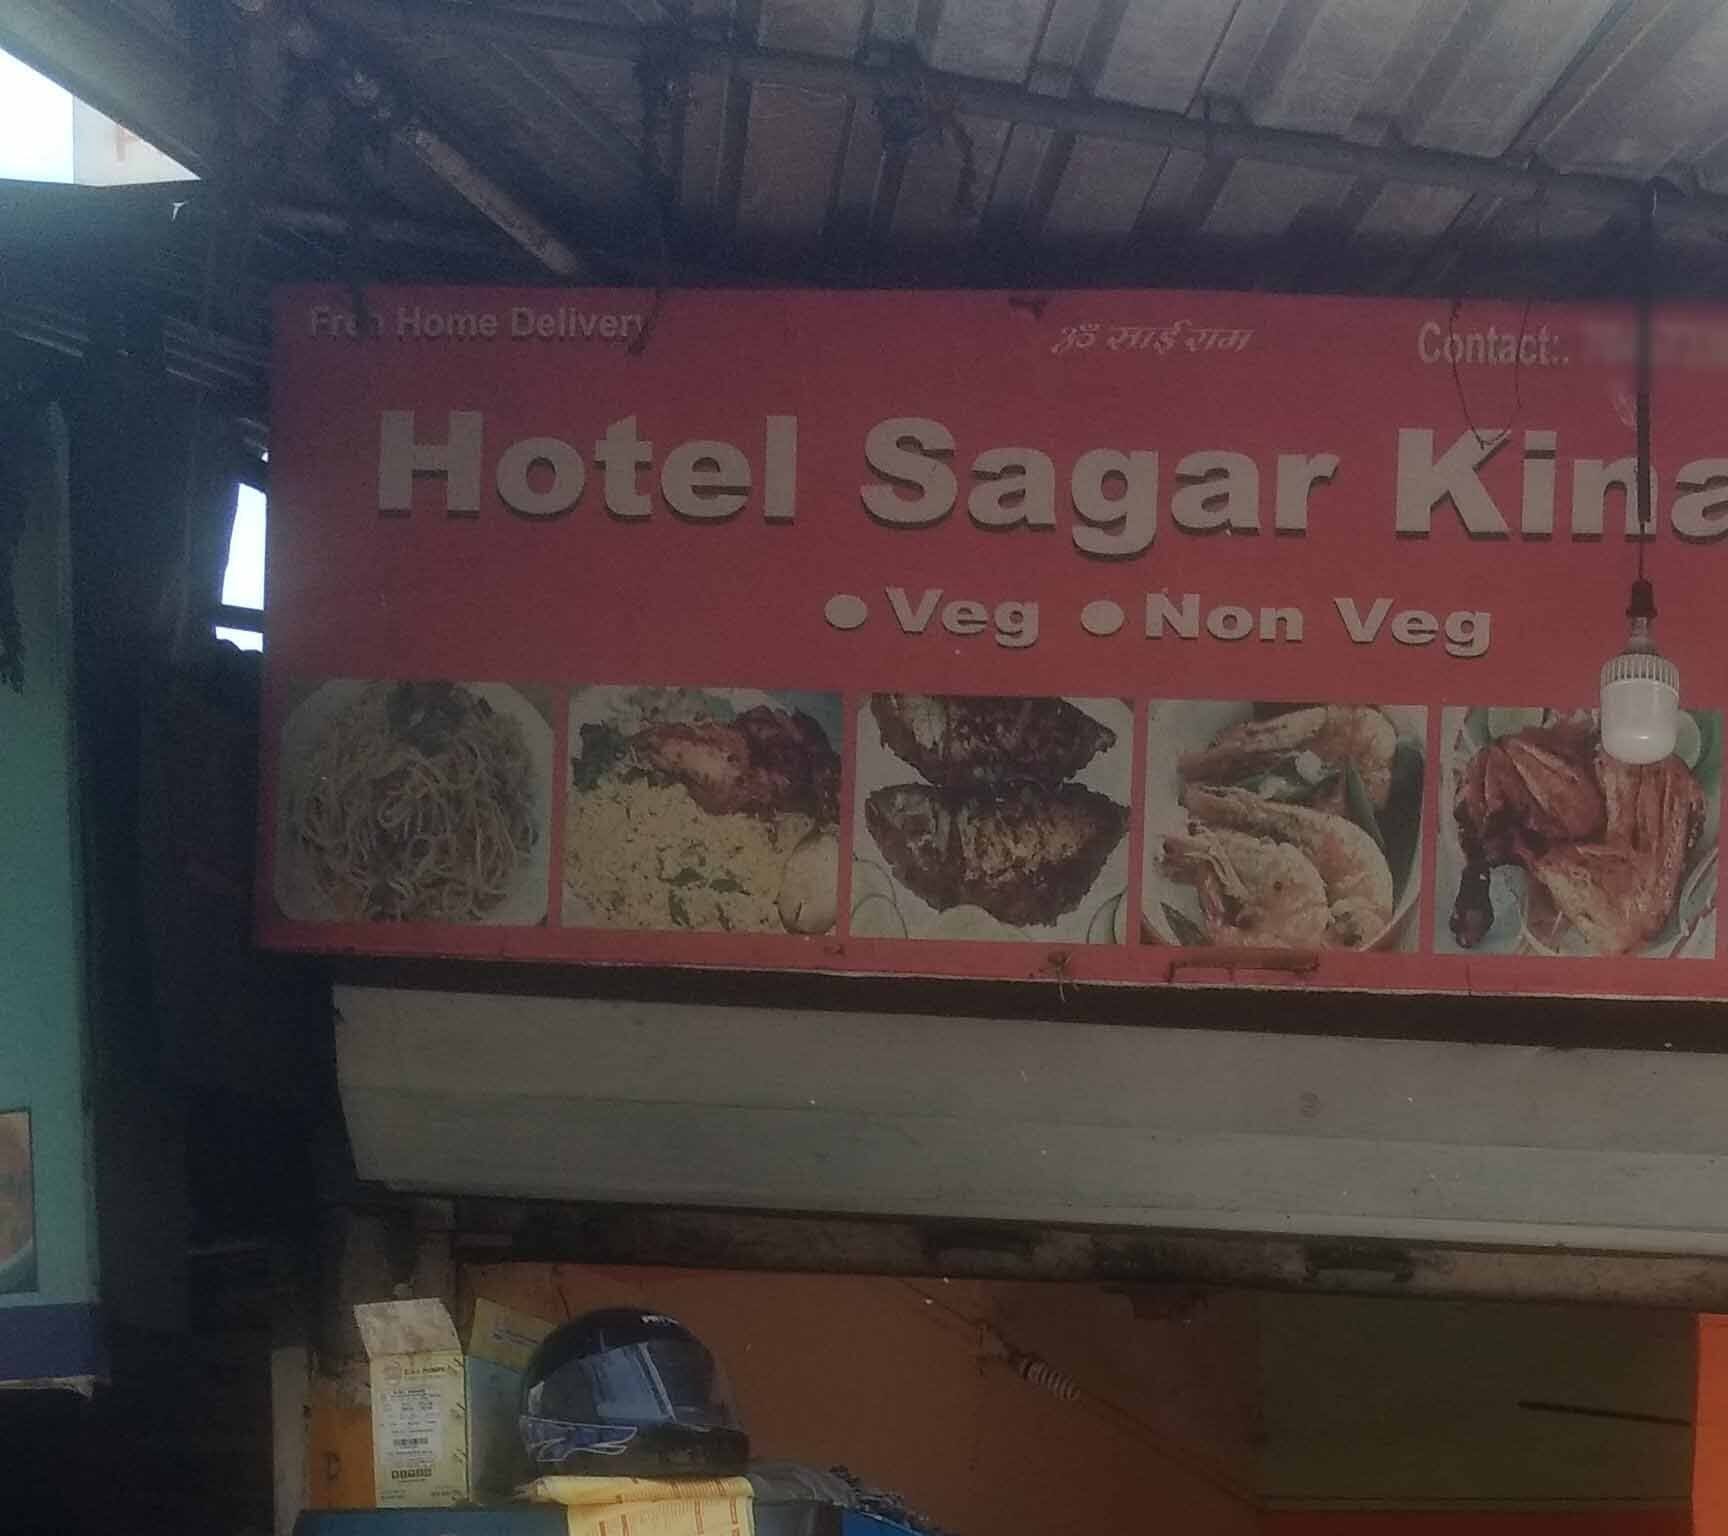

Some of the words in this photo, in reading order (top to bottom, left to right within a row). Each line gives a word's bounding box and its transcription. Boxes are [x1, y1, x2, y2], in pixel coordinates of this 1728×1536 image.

[398, 305, 497, 338] Home
[378, 409, 798, 522] Hotel
[859, 416, 1340, 558] Sagar
[885, 586, 1039, 649] Veg
[1143, 592, 1304, 644] Non
[1334, 597, 1493, 659] Veg
